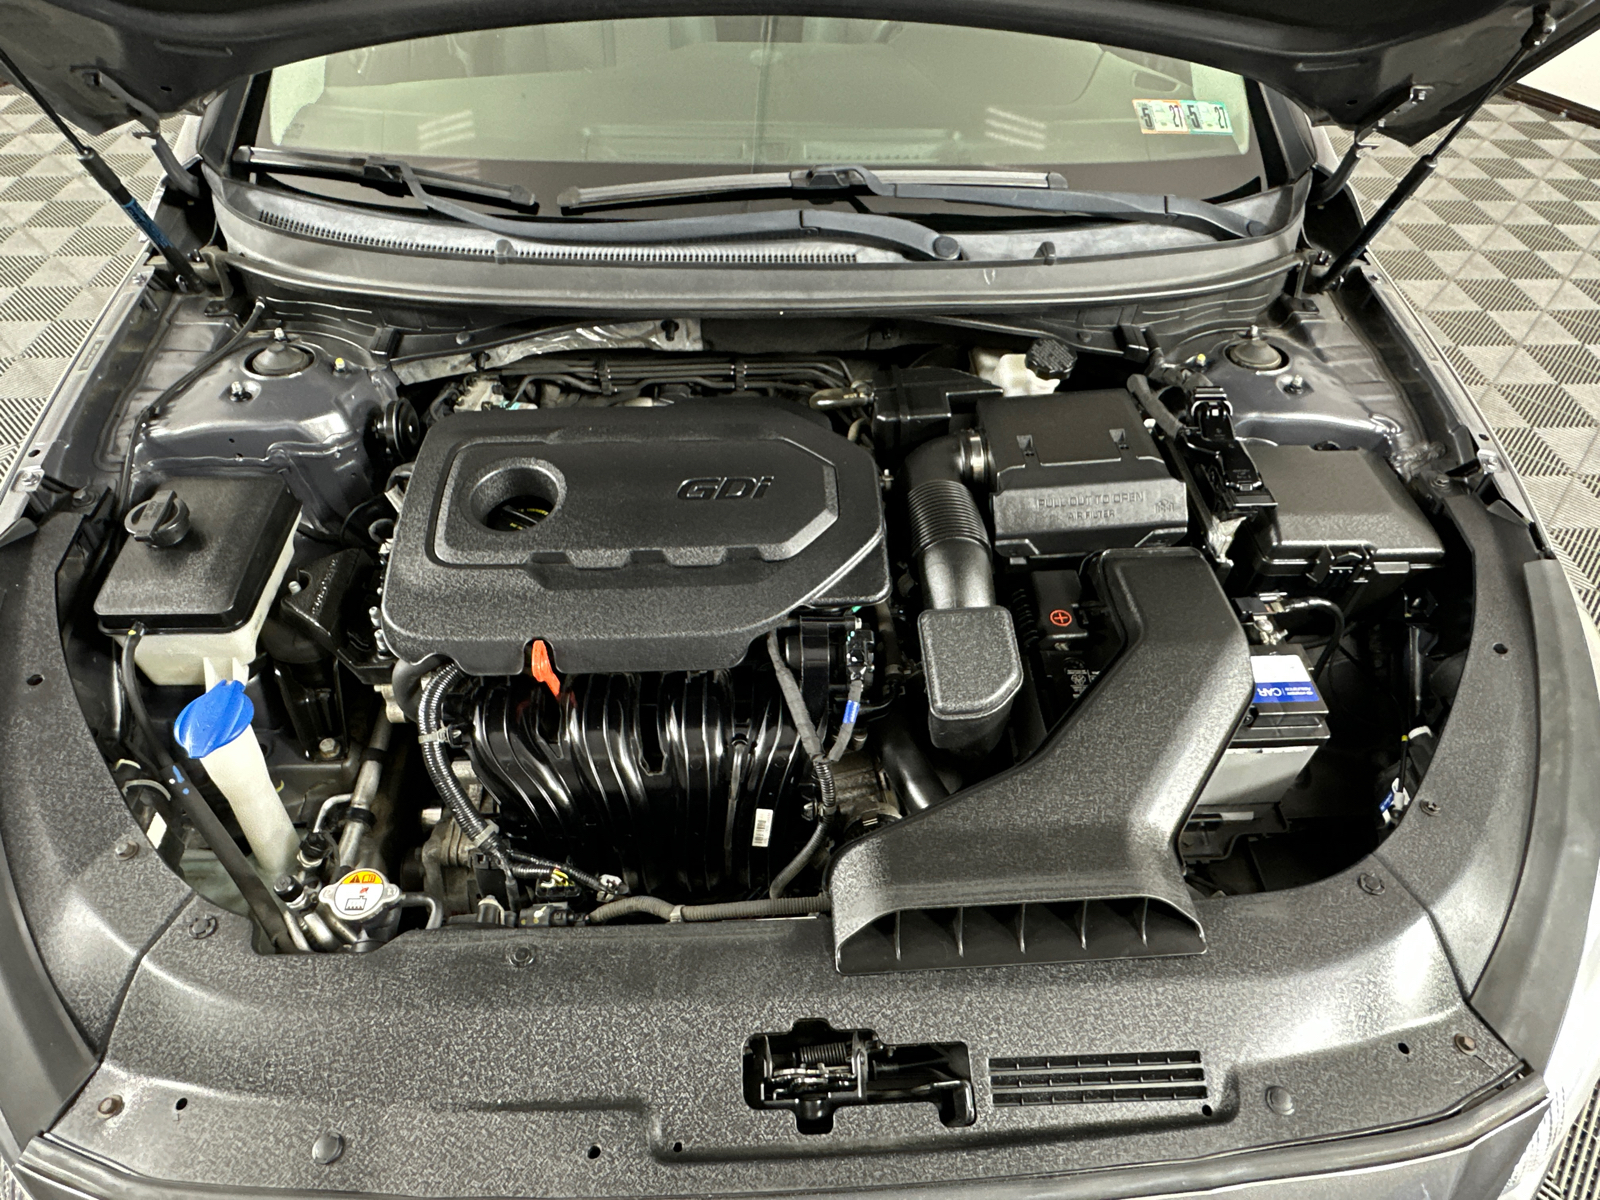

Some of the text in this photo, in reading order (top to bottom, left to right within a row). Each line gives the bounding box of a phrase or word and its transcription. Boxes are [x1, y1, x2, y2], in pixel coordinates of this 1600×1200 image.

[1141, 104, 1183, 128] 5 27
[1187, 104, 1228, 129] 5 27
[676, 475, 775, 500] GDi
[1036, 491, 1145, 509] PULL OUT TO OPEN
[1068, 509, 1116, 521] AIR FILTER
